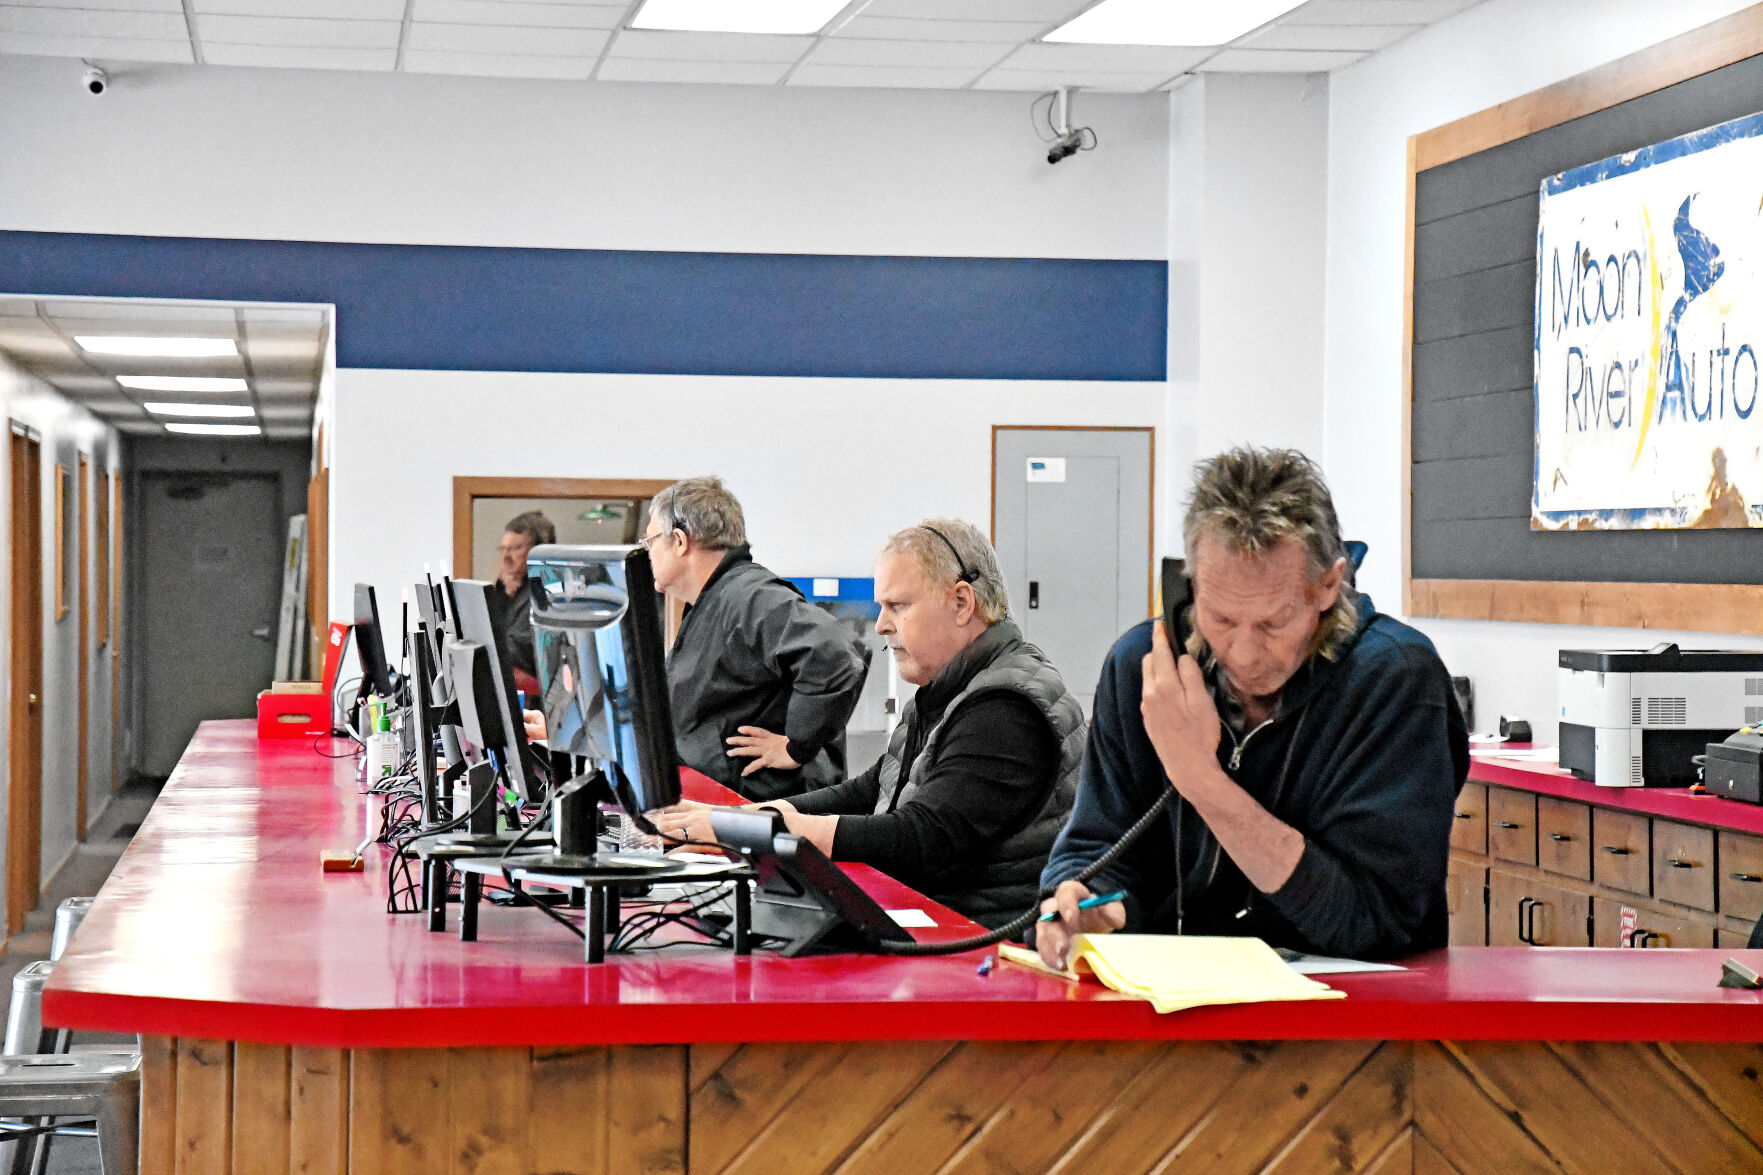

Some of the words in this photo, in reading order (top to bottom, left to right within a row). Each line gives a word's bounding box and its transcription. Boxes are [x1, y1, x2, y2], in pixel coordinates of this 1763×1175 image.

[1551, 240, 1642, 332] Moon
[1565, 345, 1639, 433] River
[1657, 322, 1759, 425] Auto
